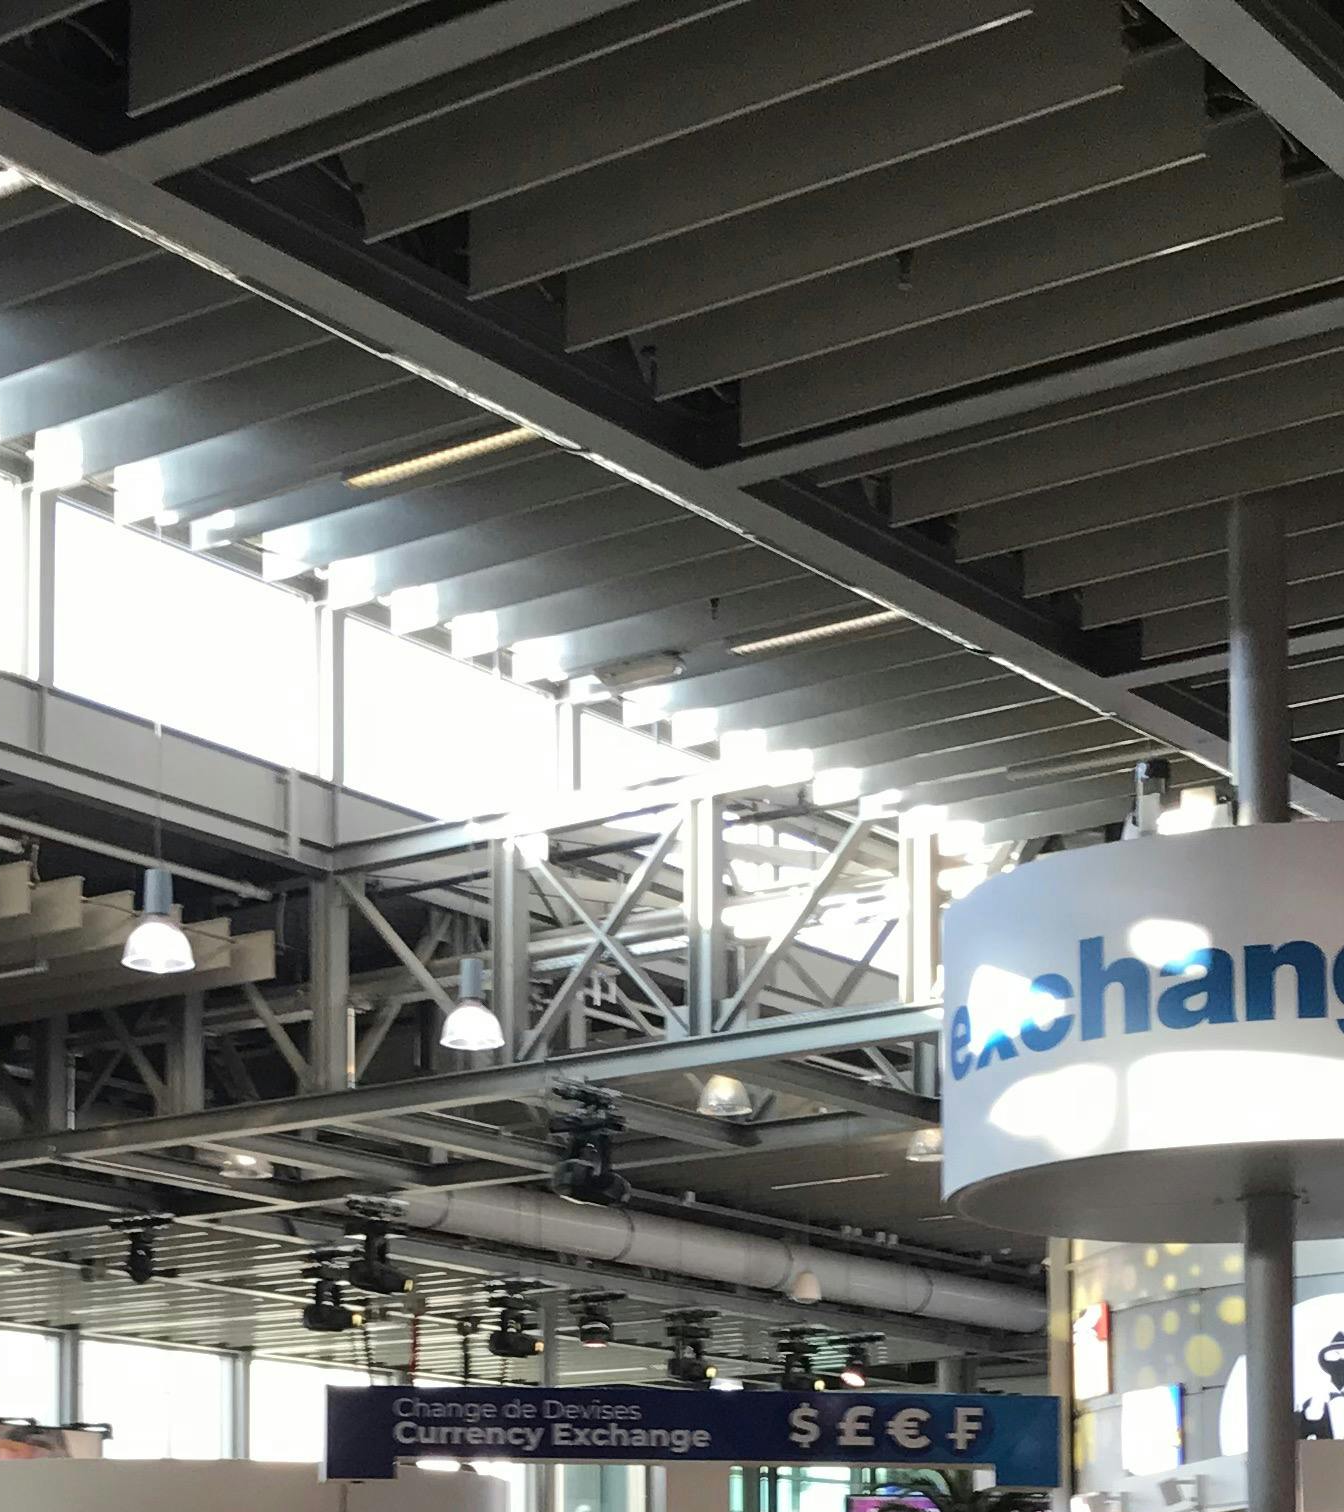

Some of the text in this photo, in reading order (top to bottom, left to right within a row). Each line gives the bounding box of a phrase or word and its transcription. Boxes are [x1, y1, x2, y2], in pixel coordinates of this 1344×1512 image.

[392, 1397, 642, 1423] Change de Devises
[788, 1402, 821, 1448] $
[838, 1405, 876, 1446] £
[885, 1407, 932, 1449] €
[393, 1420, 712, 1453] Currency Exchange
